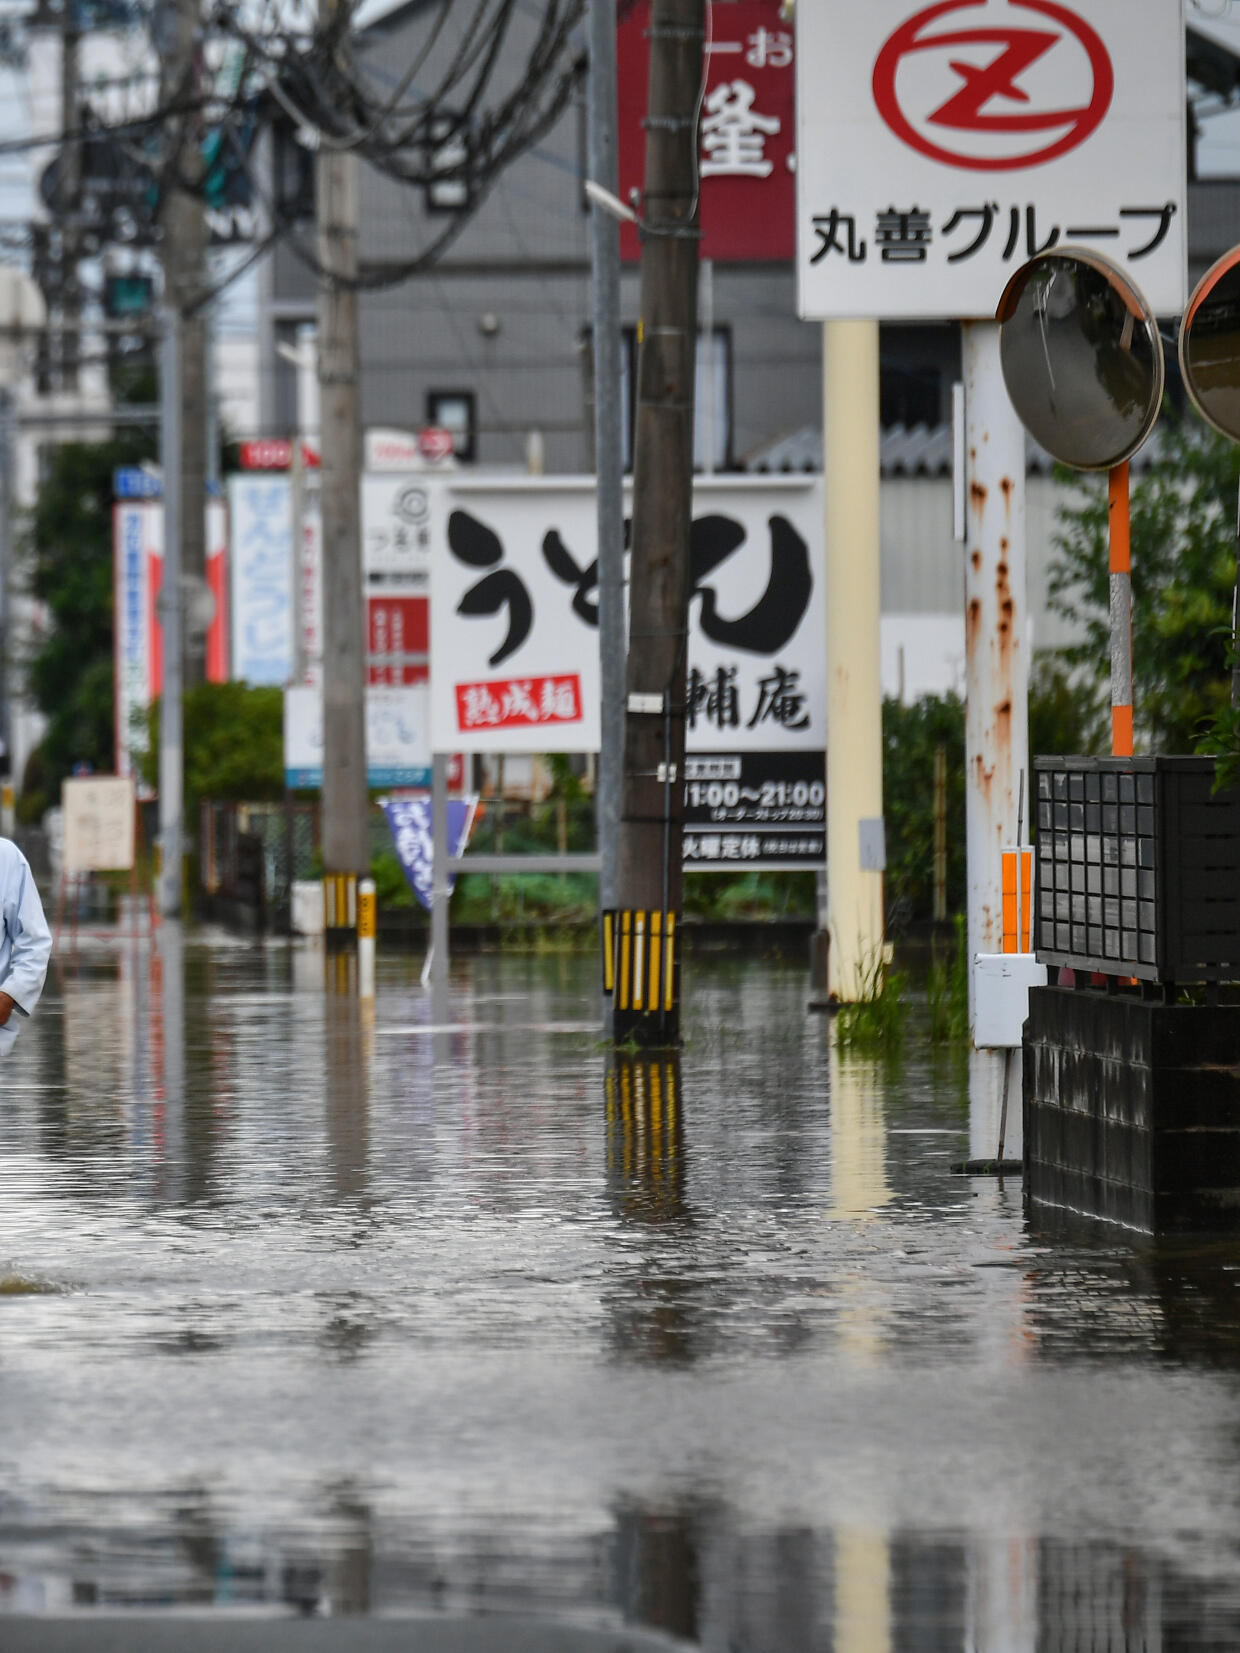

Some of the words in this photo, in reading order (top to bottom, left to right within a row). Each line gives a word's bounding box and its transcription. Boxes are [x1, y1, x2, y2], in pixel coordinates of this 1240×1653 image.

[810, 200, 1178, 264] 丸善グループ
